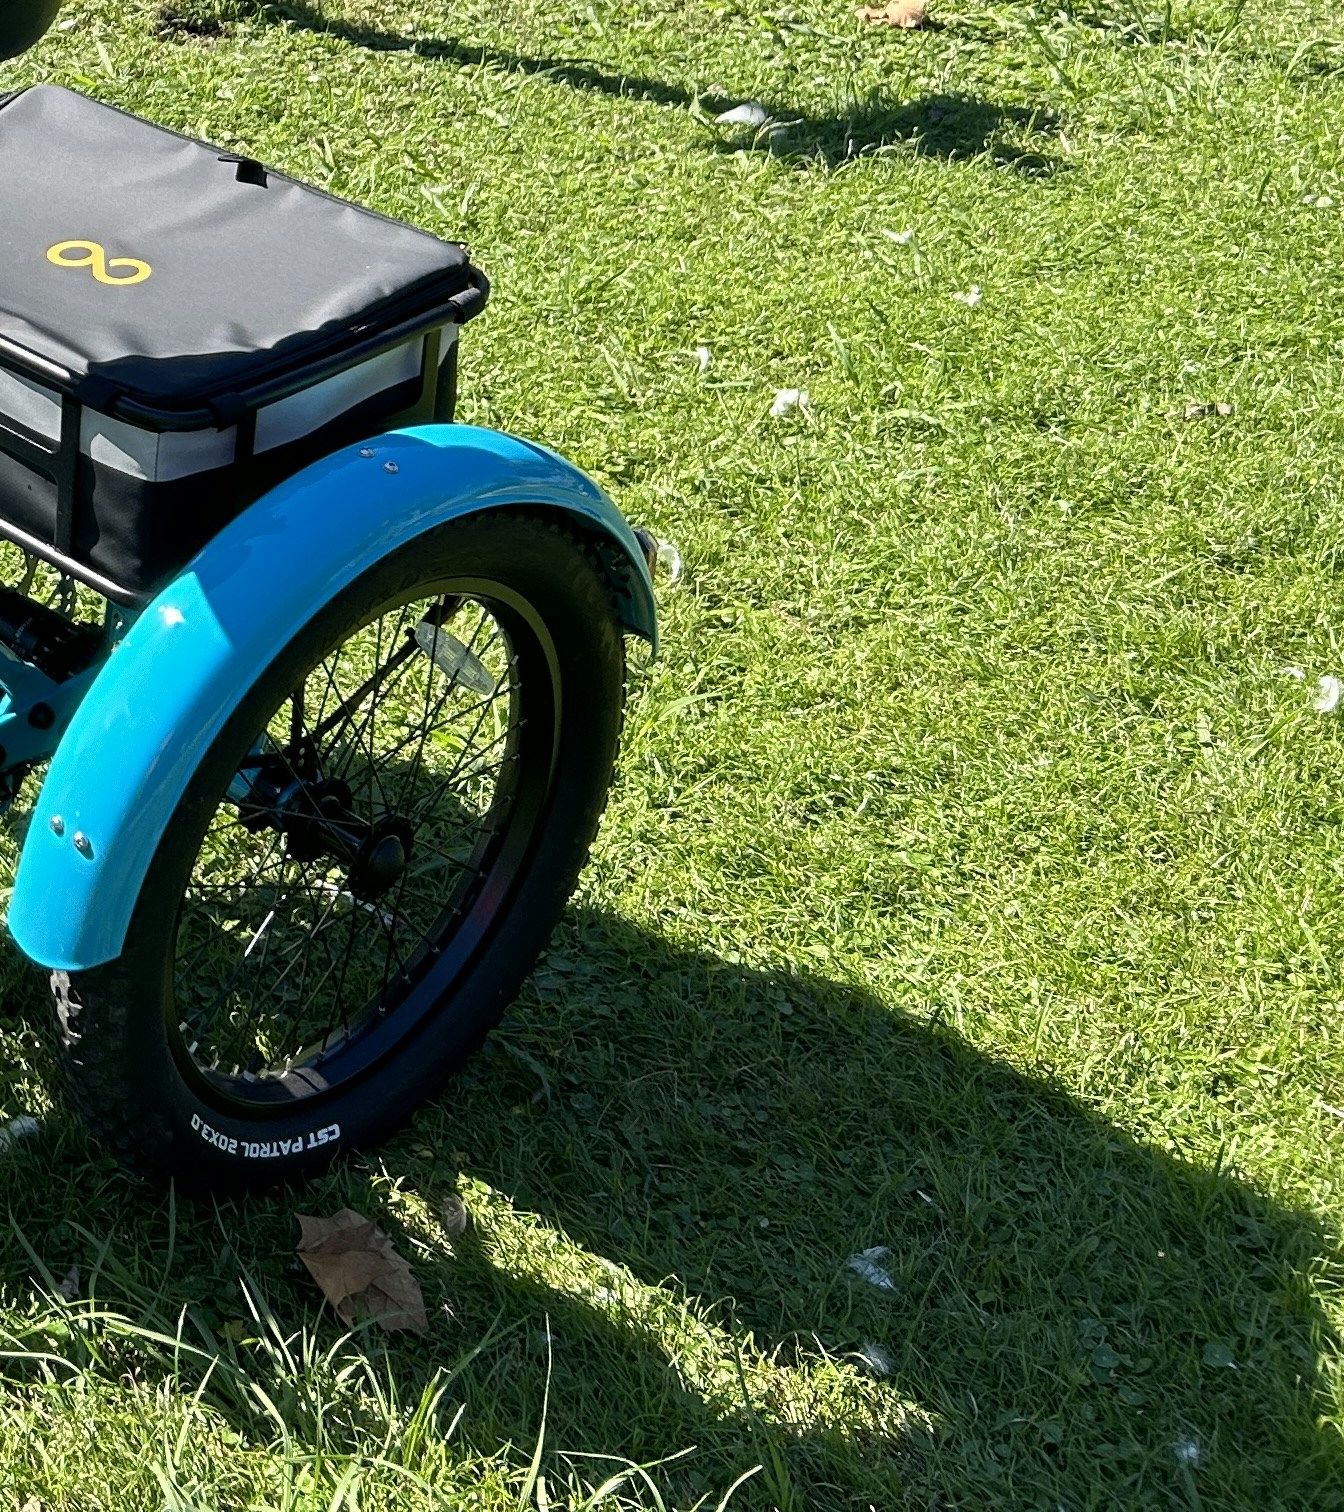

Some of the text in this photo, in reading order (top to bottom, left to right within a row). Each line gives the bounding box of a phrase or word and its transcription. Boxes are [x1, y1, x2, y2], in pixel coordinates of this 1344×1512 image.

[190, 1112, 341, 1159] CST PATROL 20X3.0
